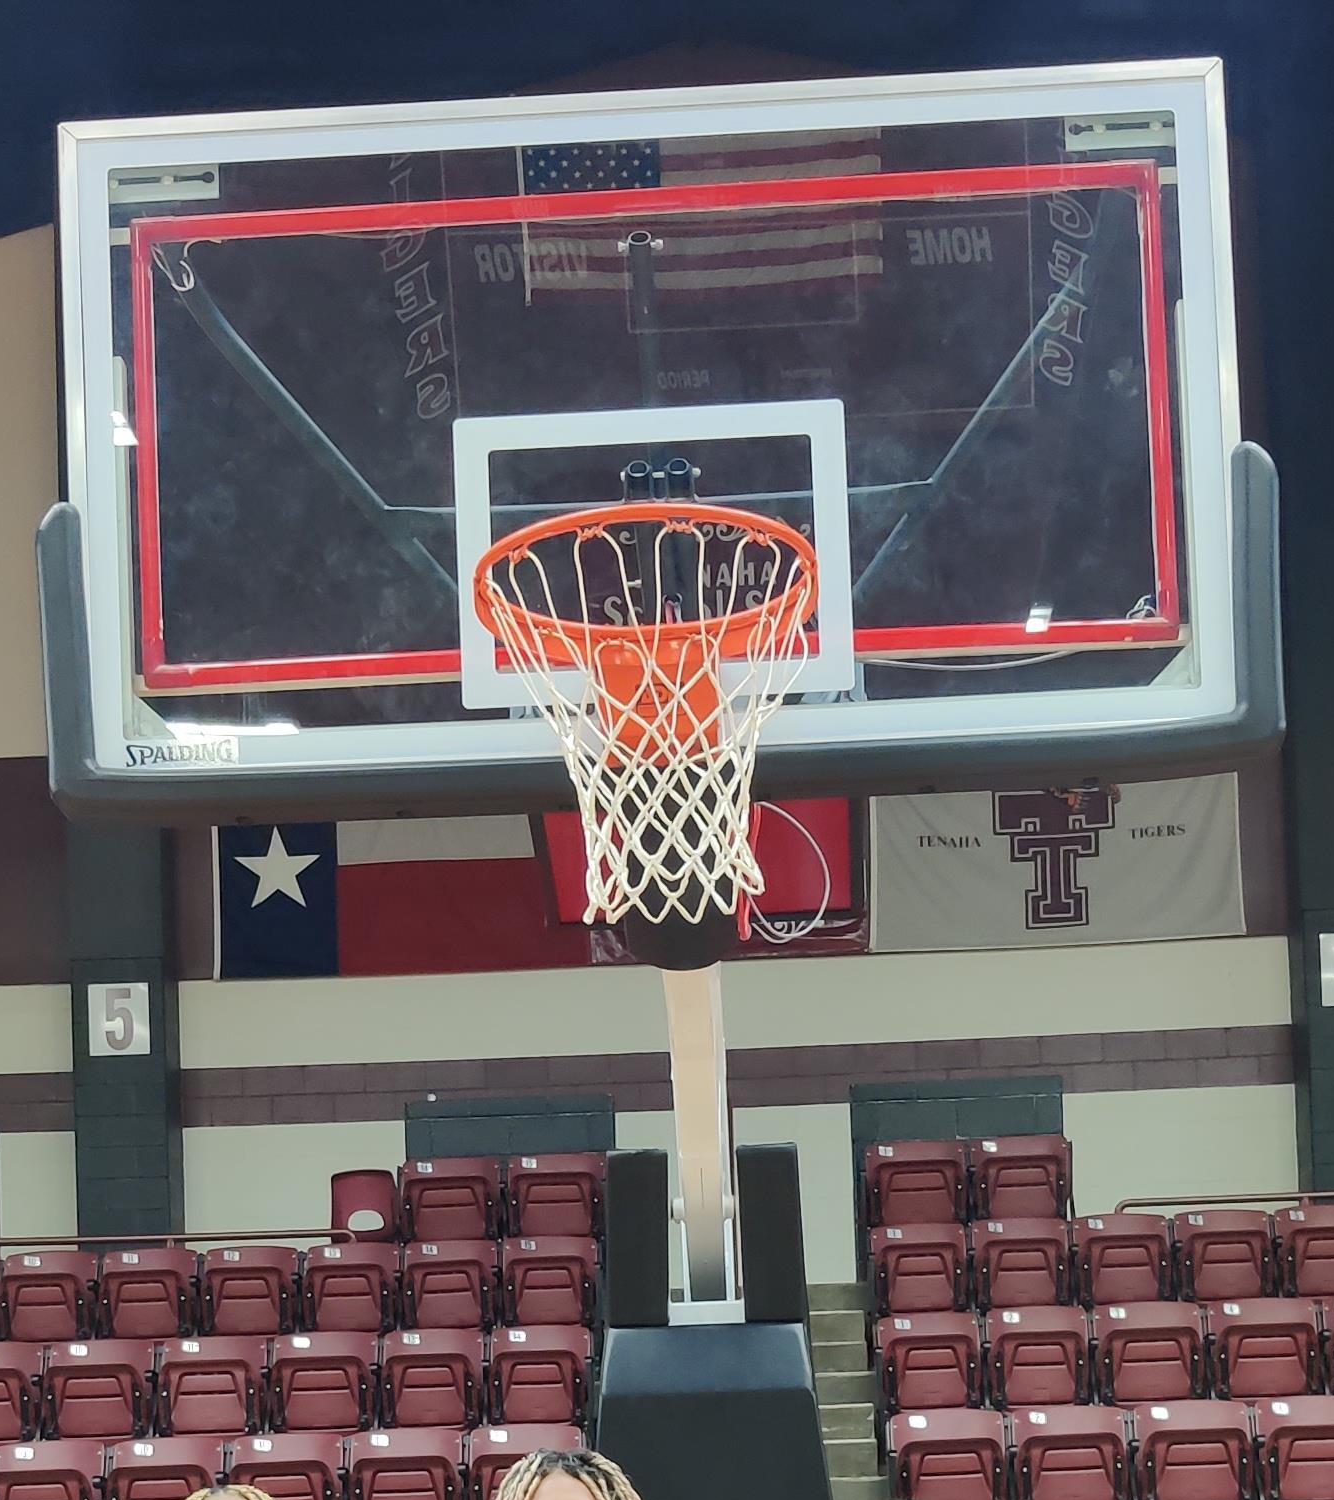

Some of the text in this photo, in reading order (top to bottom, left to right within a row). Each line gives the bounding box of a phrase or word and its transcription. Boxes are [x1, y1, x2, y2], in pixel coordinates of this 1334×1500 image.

[125, 739, 236, 767] SPALDING
[916, 834, 982, 849] TENAHA
[1128, 823, 1186, 840] TIGERS
[104, 987, 134, 1051] 5
